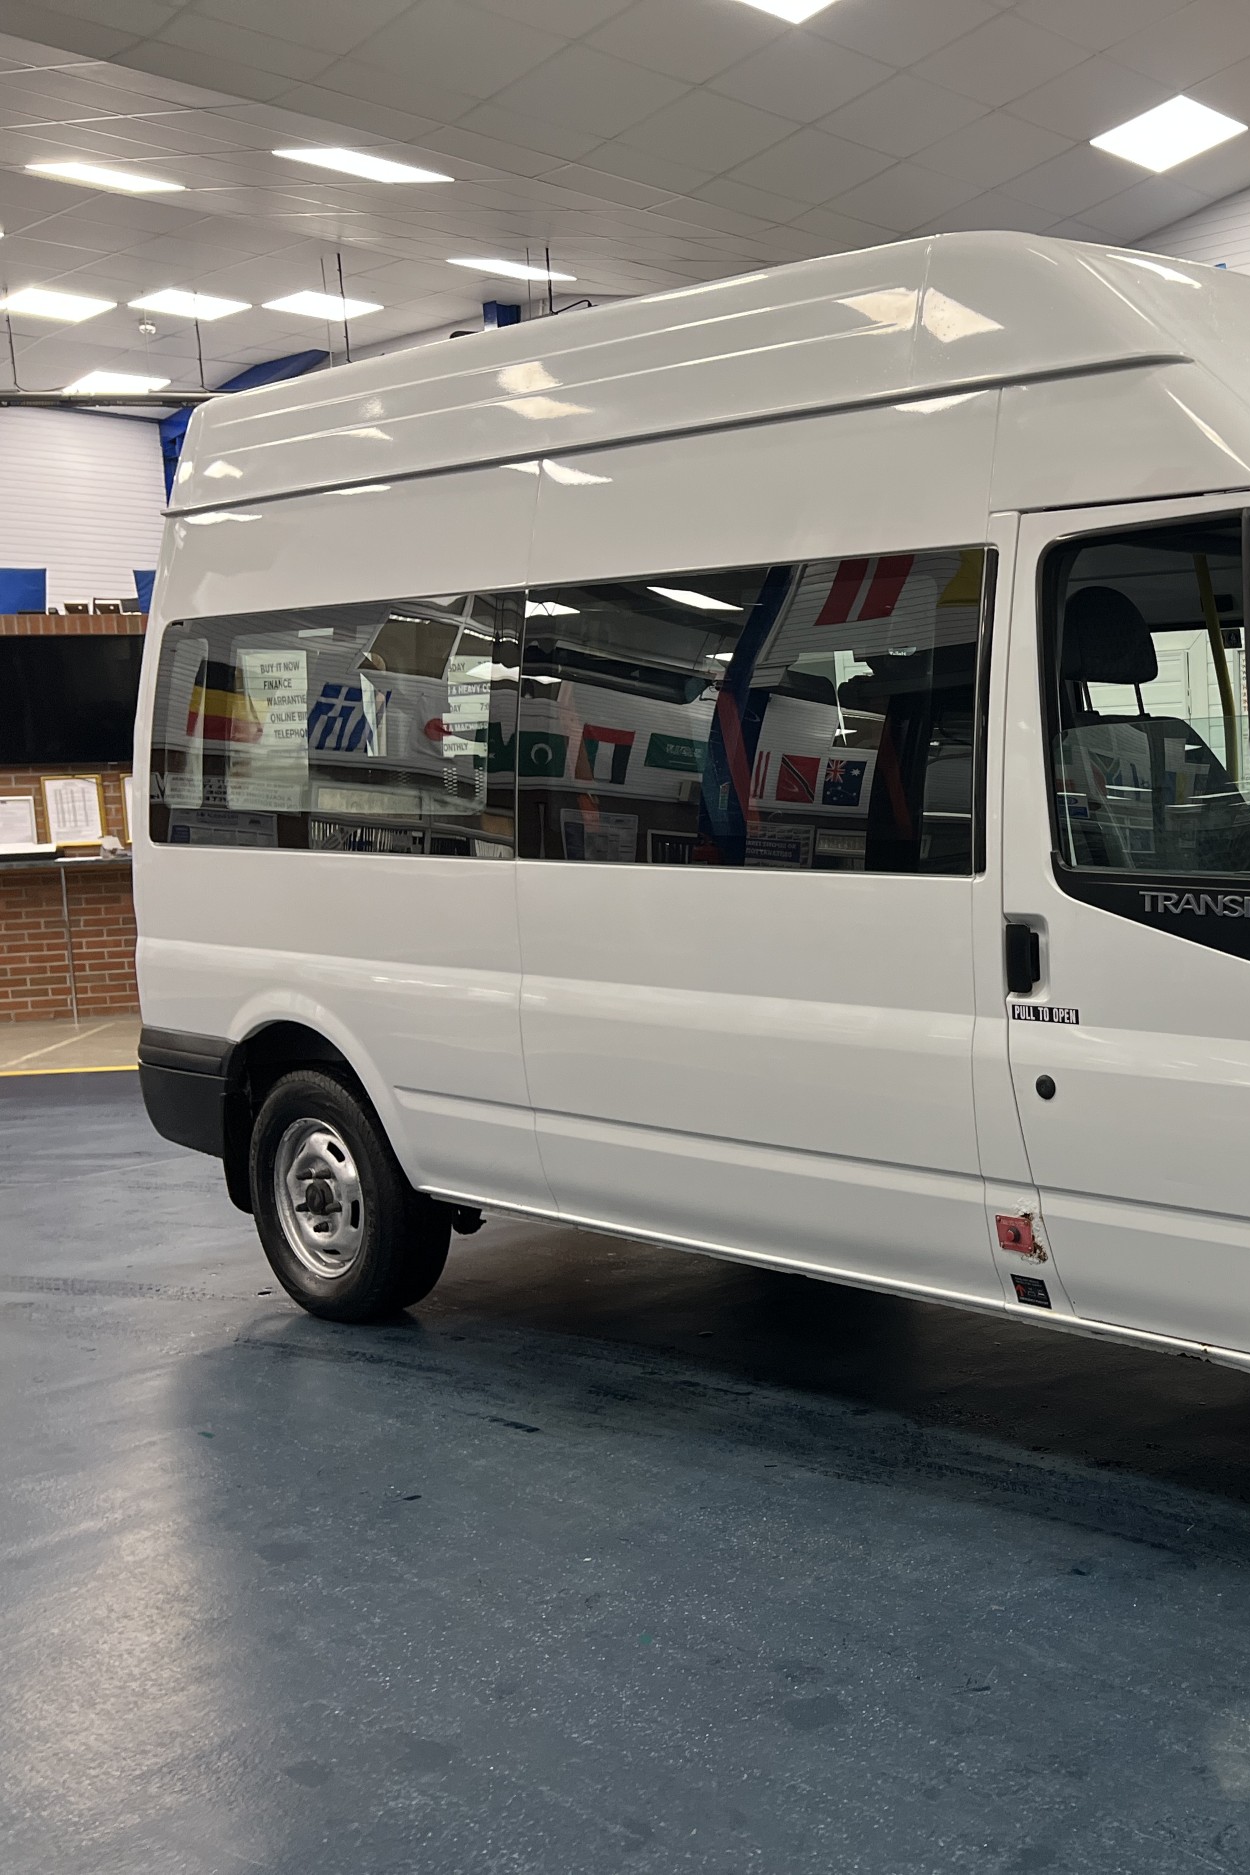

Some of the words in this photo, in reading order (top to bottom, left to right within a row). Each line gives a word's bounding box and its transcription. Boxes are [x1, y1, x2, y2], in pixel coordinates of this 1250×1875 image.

[260, 664, 273, 674] BUY
[276, 663, 282, 671] IT
[284, 661, 299, 671] NOW
[264, 679, 292, 690] FINANCE
[458, 685, 480, 694] HEAVY
[271, 713, 296, 723] ONLINE
[1014, 1005, 1036, 1021] PULL
[1038, 1007, 1050, 1022] TO
[1052, 1008, 1077, 1024] OPEN
